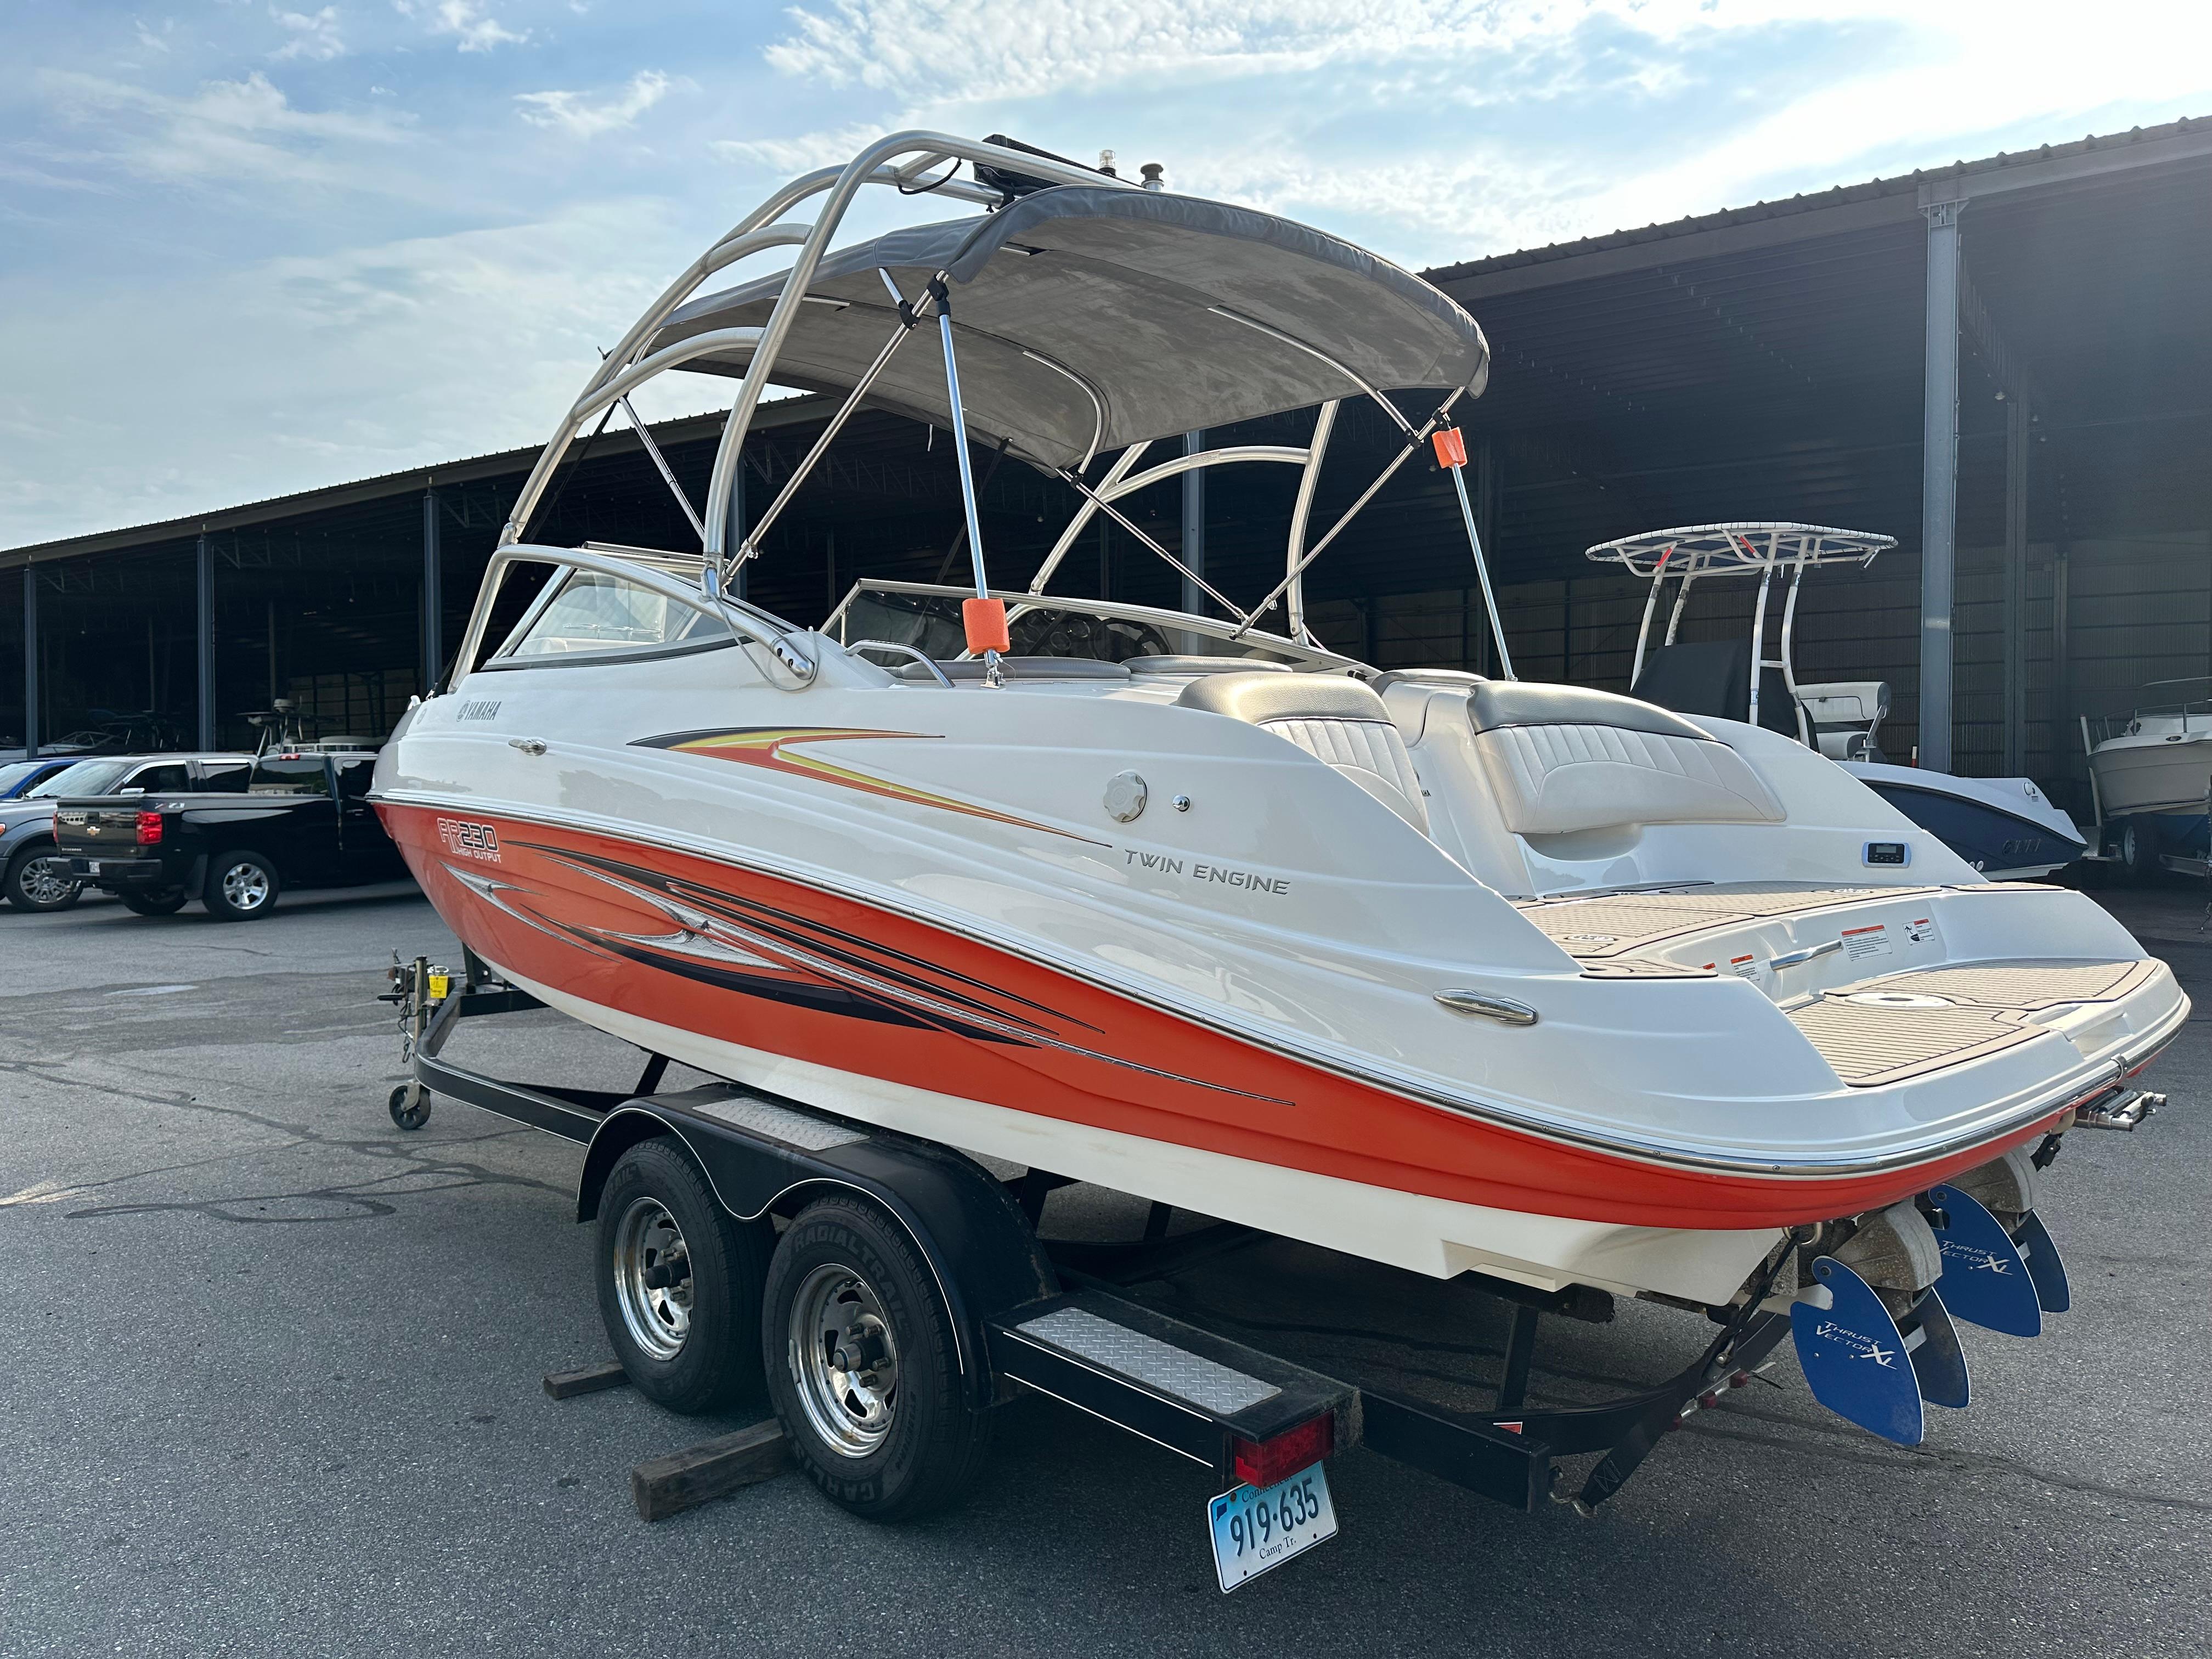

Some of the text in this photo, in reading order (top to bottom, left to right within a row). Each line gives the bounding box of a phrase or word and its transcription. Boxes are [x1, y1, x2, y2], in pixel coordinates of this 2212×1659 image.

[464, 701, 502, 720] YAMAHA
[437, 817, 499, 854] AR230
[458, 847, 501, 864] HIGH OUTPUT
[1125, 849, 1290, 895] TWIN ENGINE
[1942, 1240, 1997, 1256] THRUST
[1816, 1325, 1873, 1353] VECTOR
[1825, 1321, 1883, 1345] THRUST
[1259, 1536, 1296, 1559] Camp Tr.
